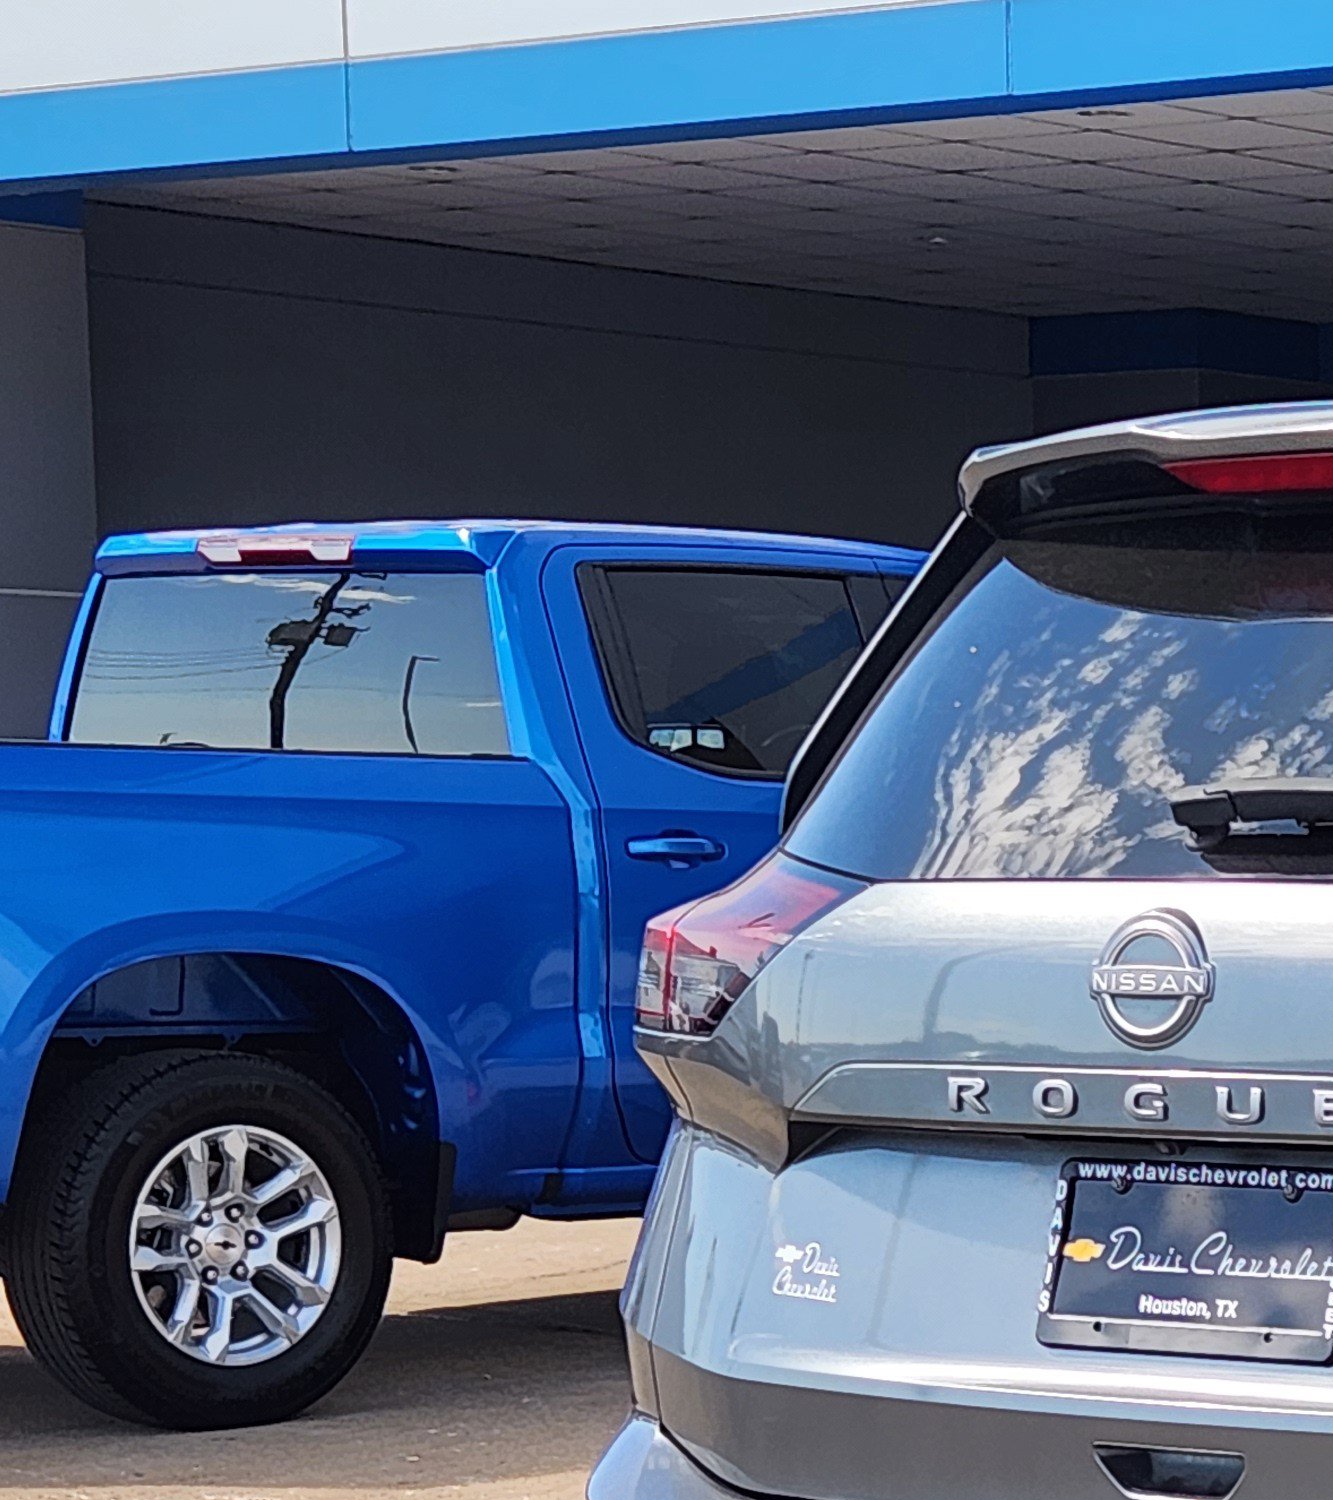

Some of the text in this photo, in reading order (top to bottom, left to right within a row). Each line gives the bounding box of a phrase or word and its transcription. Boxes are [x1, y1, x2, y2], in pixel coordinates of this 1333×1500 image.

[1092, 971, 1206, 994] NISSAN
[1037, 1179, 1068, 1313] DAVIS
[1106, 1225, 1189, 1274] Davis
[1138, 1293, 1239, 1320] Houston, TX
